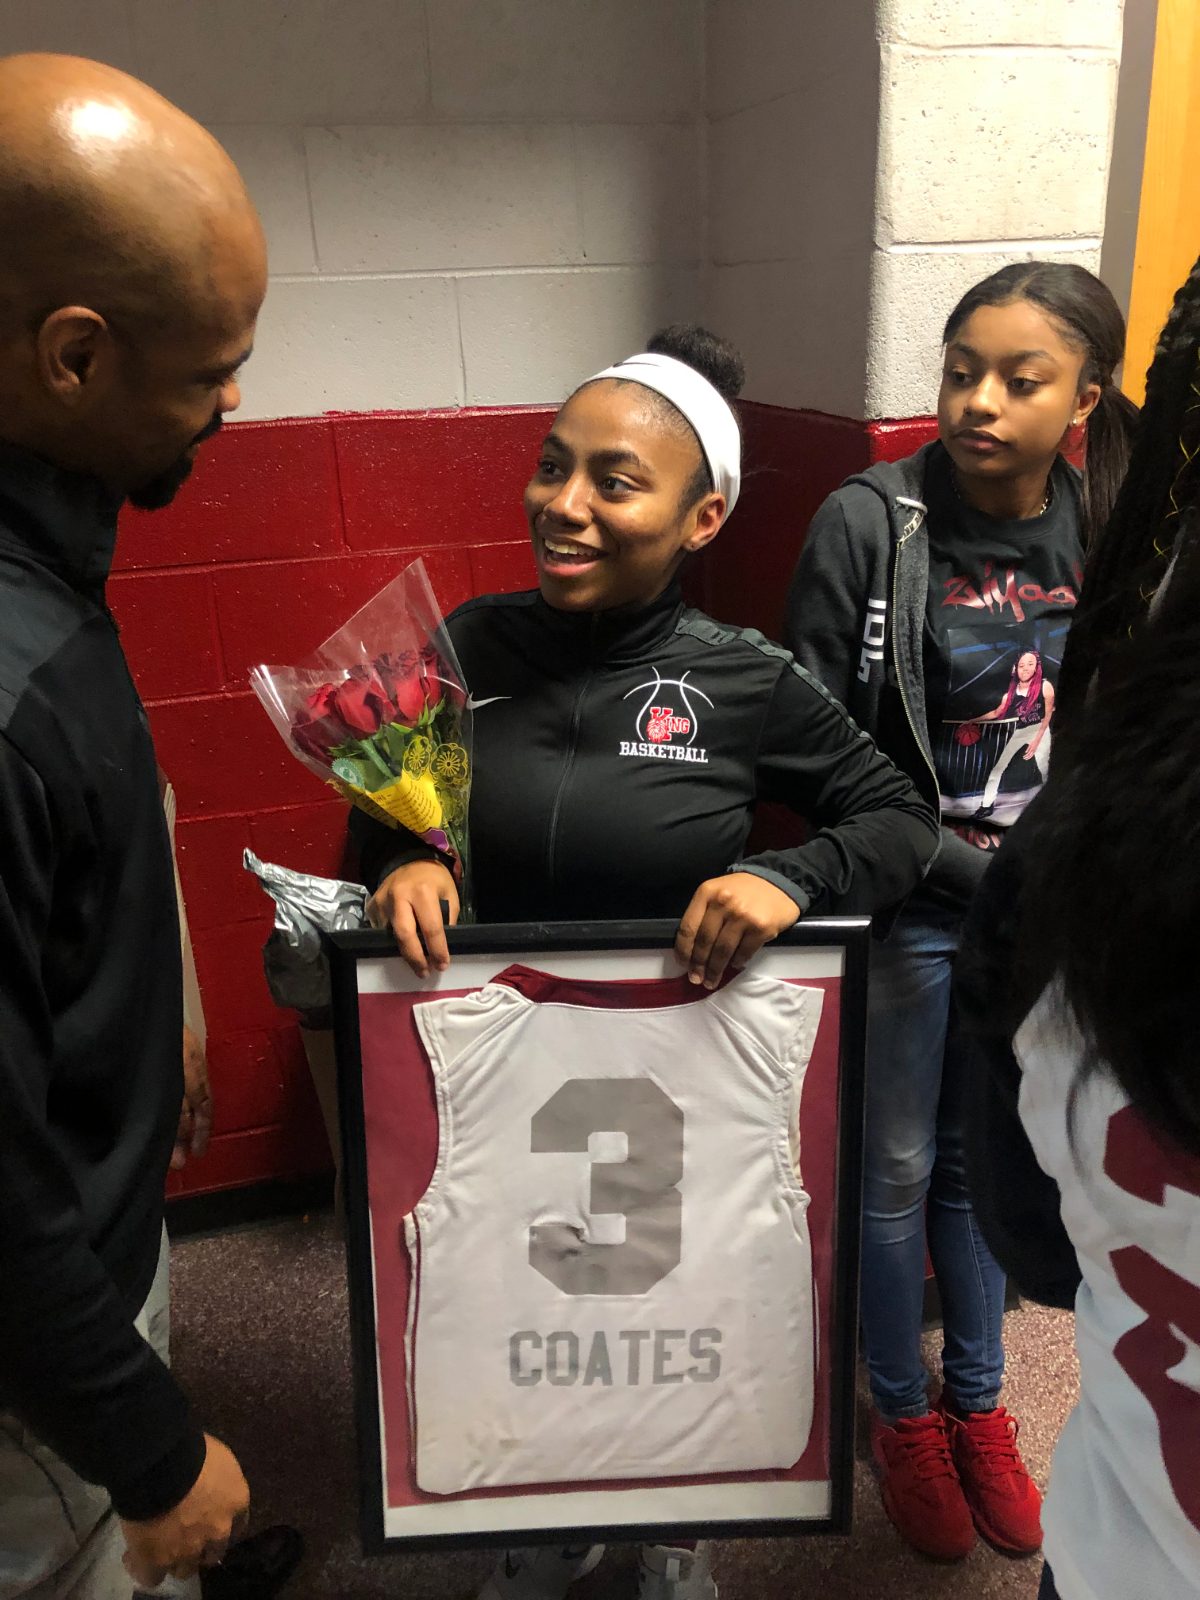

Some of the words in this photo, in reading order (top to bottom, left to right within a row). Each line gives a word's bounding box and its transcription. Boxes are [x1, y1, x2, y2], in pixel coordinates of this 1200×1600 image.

[619, 741, 709, 763] BASKETBALL
[529, 1078, 684, 1295] 3
[509, 1327, 723, 1386] COATES
